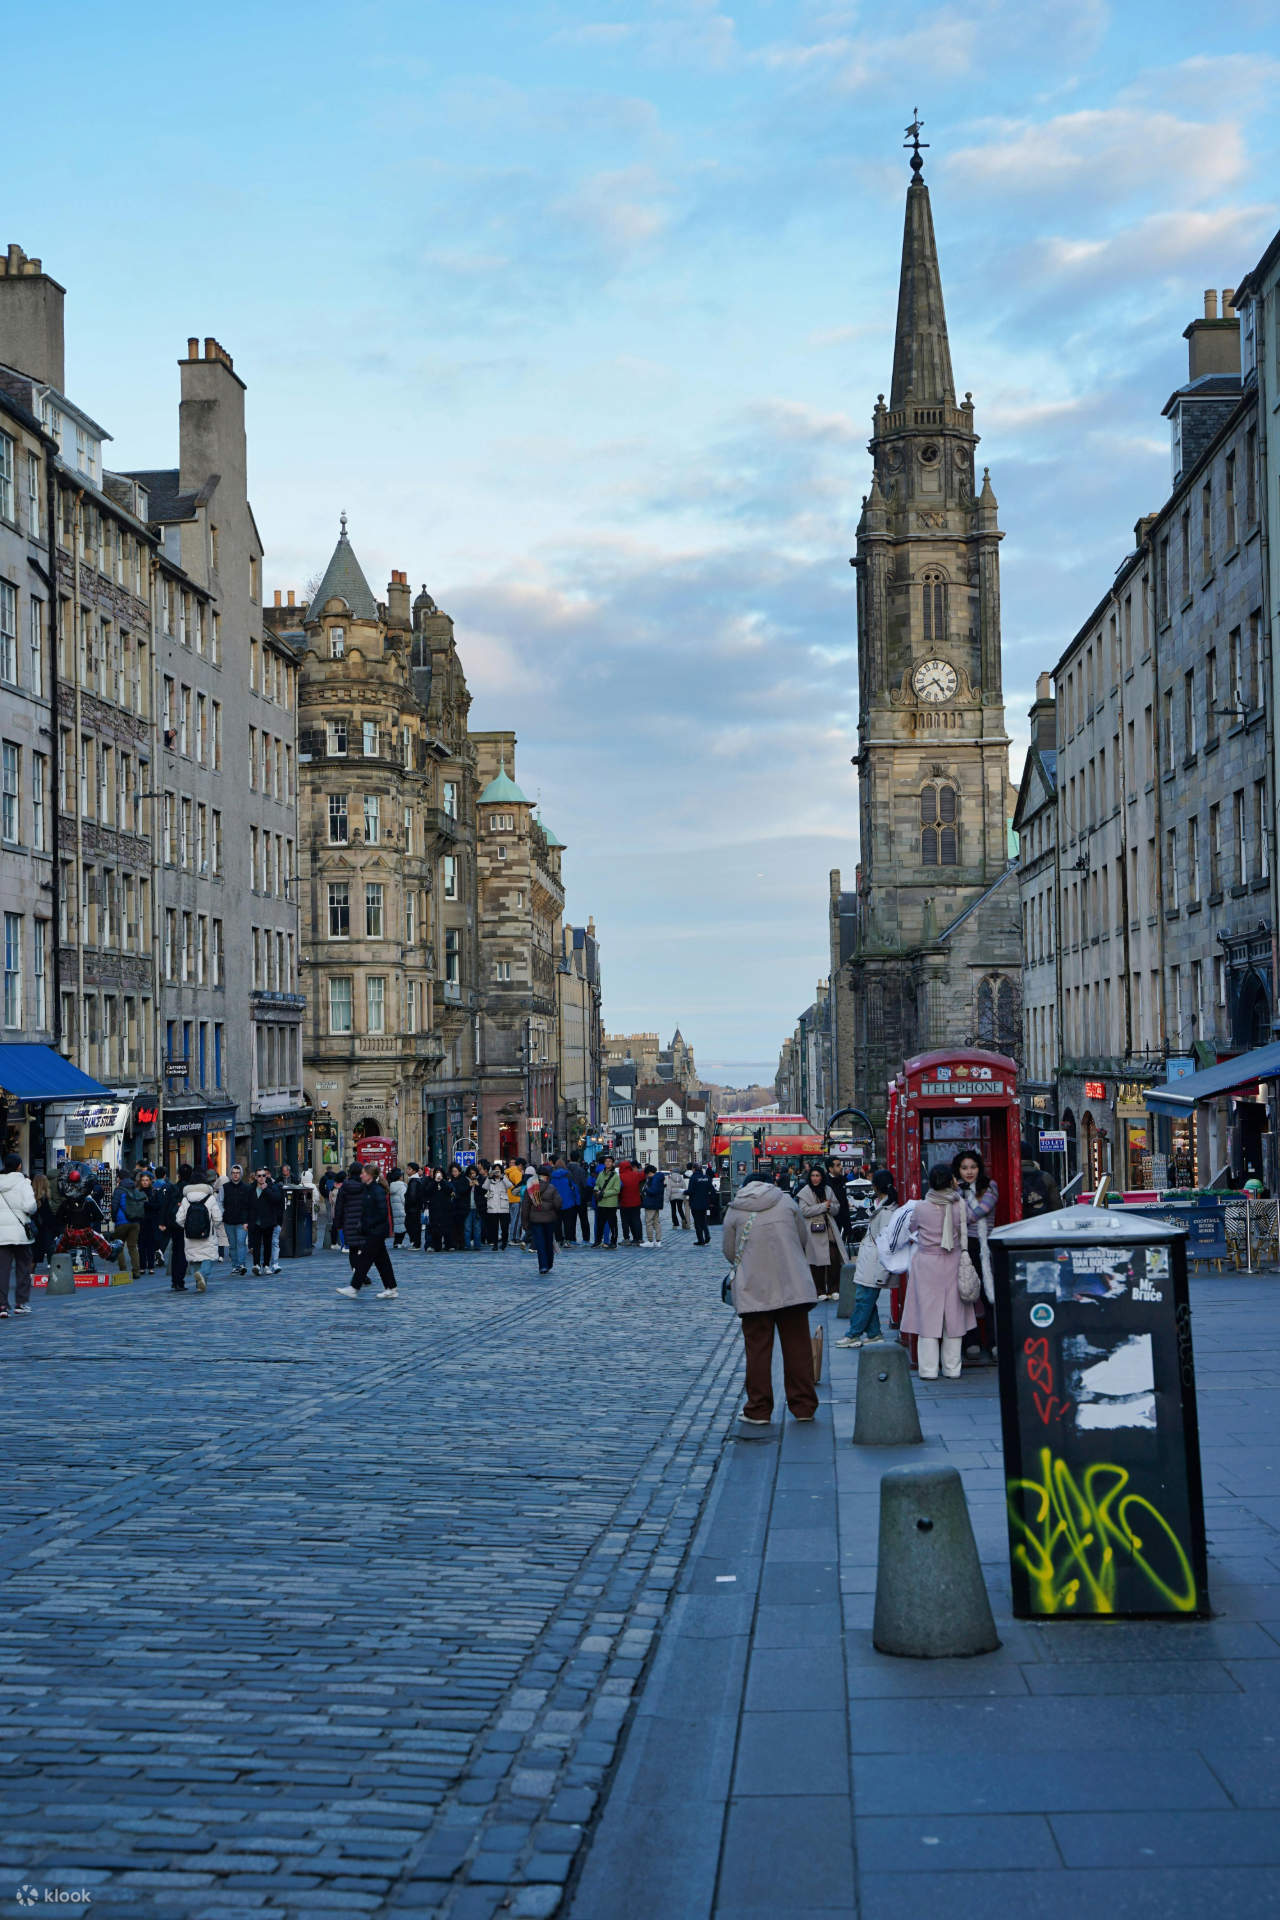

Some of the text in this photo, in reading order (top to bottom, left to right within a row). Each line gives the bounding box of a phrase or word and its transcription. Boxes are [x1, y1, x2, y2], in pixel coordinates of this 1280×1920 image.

[927, 1082, 1000, 1094] TELEPHONE
[1140, 1278, 1155, 1291] Mr.
[1132, 1286, 1163, 1302] Bruce
